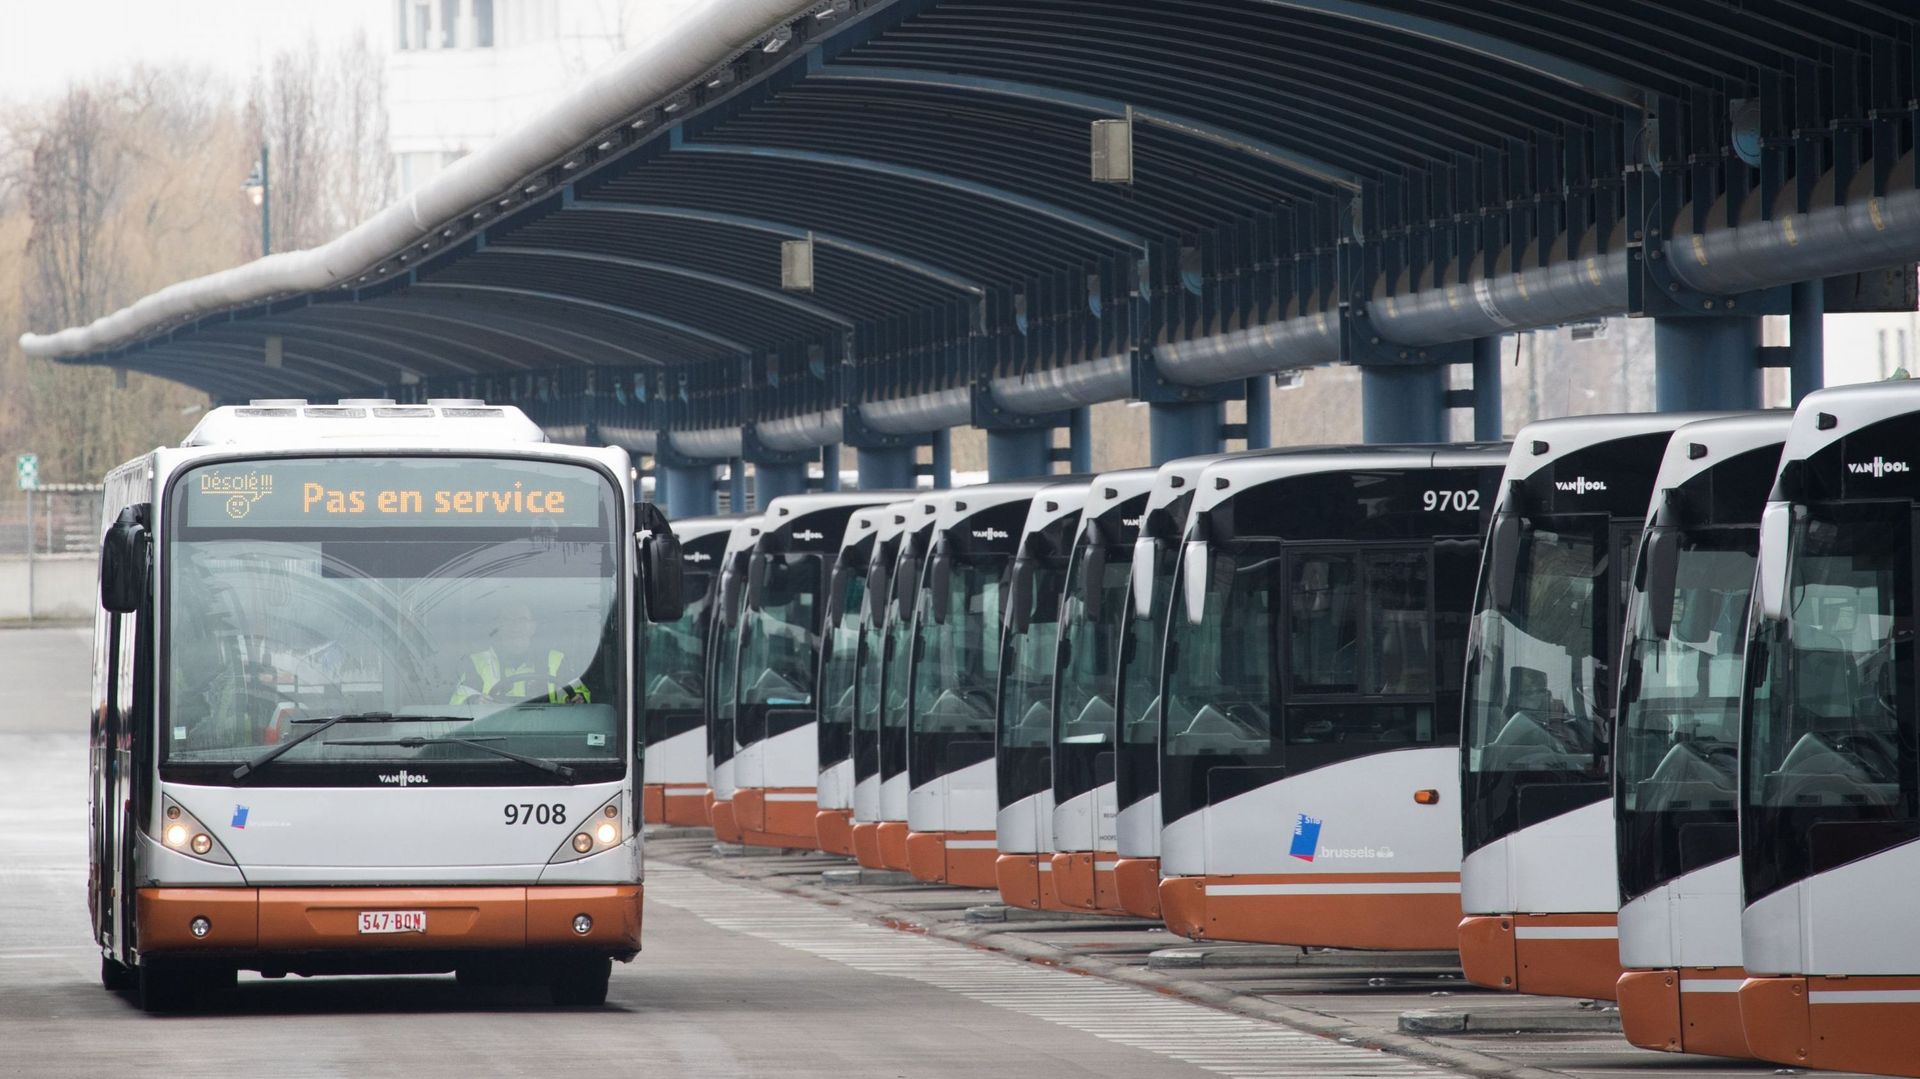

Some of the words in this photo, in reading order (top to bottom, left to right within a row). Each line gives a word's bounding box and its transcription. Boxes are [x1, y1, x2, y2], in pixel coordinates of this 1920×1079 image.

[303, 482, 365, 513] Pas
[377, 490, 422, 513] en
[434, 480, 565, 513] service
[1423, 489, 1480, 511] 9702
[503, 803, 566, 825] 9708
